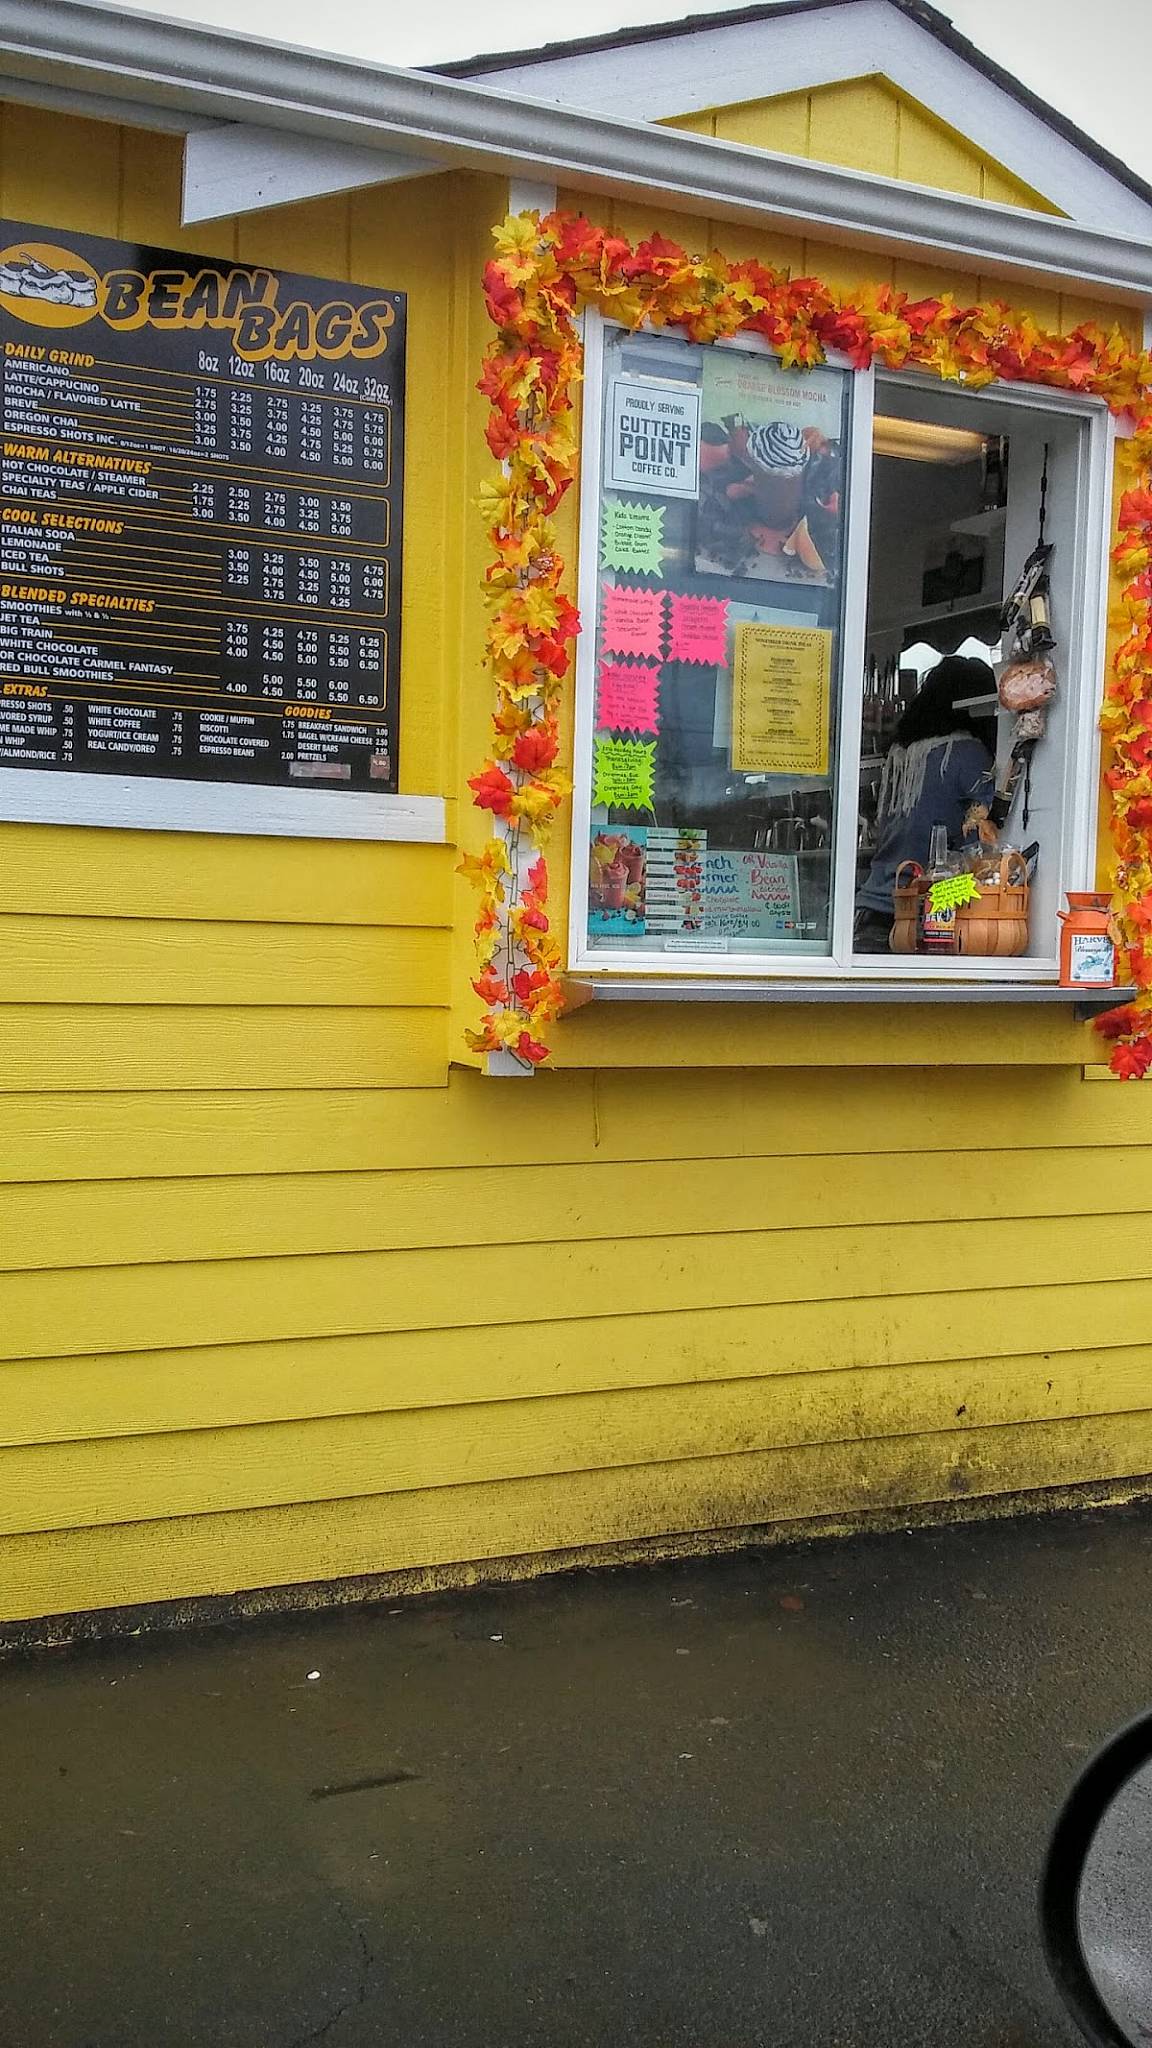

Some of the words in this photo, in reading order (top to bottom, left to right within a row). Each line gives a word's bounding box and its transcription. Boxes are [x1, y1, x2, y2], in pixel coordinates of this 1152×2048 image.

[101, 270, 277, 329] BEAN
[233, 302, 393, 359] BAGS
[5, 342, 46, 359] DAILY
[49, 350, 96, 367] GRIND
[198, 350, 219, 372] 8oz
[229, 356, 254, 378] 12oz
[264, 361, 290, 384] 16oz
[299, 367, 324, 389] 20oz
[333, 372, 358, 395] 24oz
[364, 378, 390, 399] 32oz
[4, 359, 70, 376] AMERICANO
[196, 386, 216, 398] 1.75
[232, 392, 251, 402] 2.25
[268, 397, 287, 408] 2.75
[302, 402, 321, 413] 3.25
[334, 407, 353, 418] 3.75
[364, 412, 384, 422] 4.75
[4, 384, 44, 398] MOCHA
[54, 390, 108, 407] FLAVORED
[110, 398, 141, 411] LATTE
[4, 371, 100, 393] LATTE/CAPPUCINO
[196, 399, 216, 410] 2.75
[231, 404, 252, 414] 3.25
[268, 409, 287, 420] 3.75
[302, 414, 321, 425] 4.25
[334, 420, 353, 430] 4.75
[364, 424, 384, 434] 5.75
[4, 397, 38, 410] BREVE
[626, 398, 655, 411] PROUDLY
[658, 402, 684, 415] SERVING
[4, 410, 50, 424] OREGON
[52, 416, 78, 428] CHAI
[4, 422, 58, 436] ESPRESSO
[60, 430, 94, 442] SHOTS
[96, 435, 118, 445] INC.
[620, 415, 691, 440] CUTTERS
[620, 432, 690, 466] POINT
[4, 443, 50, 460] WARM
[53, 450, 152, 474] ALTERNATIVES
[632, 462, 662, 476] COFFEE
[664, 467, 678, 478] CO.
[2, 460, 24, 471] HOT
[26, 462, 89, 479] CHOCOLATE
[98, 472, 146, 486] STEAMER
[193, 483, 214, 494] 2.25
[229, 488, 249, 498] 2.50
[265, 492, 285, 502] 2.75
[300, 497, 319, 507] 3.00
[332, 501, 350, 511] 3.50
[2, 485, 28, 496] CHAI
[31, 488, 57, 500] TEAS
[2, 472, 57, 487] SPECIALTY
[59, 479, 85, 491] TEAS
[93, 484, 126, 496] APPLE
[128, 488, 159, 500] CIDER
[193, 496, 214, 506] 1.75
[229, 500, 249, 510] 2.25
[265, 504, 285, 515] 2.75
[299, 509, 319, 519] 3.25
[332, 513, 350, 523] 3.75
[2, 508, 38, 524] COOL
[41, 512, 124, 535] SELECTIONS
[1, 524, 42, 537] ITALIAN
[45, 528, 76, 541] SODA
[229, 550, 248, 560] 3.00
[264, 553, 283, 564] 3.25
[300, 558, 318, 568] 3.50
[331, 561, 350, 571] 3.75
[364, 566, 383, 576] 4.75
[1, 550, 26, 560] ICED
[28, 552, 50, 563] TEA
[1, 537, 62, 552] LEMONADE
[228, 562, 248, 572] 3.50
[263, 566, 283, 576] 4.00
[299, 570, 318, 580] 4.50
[331, 573, 350, 583] 5.00
[364, 577, 383, 587] 6.00
[1, 562, 28, 573] BULL
[30, 564, 64, 576] SHOTS
[0, 584, 66, 603] BLENDED
[70, 592, 156, 612] SPECIALTIES
[0, 613, 17, 622] JET
[20, 614, 40, 625] TEA
[0, 600, 62, 614] SMOOTHIES
[65, 609, 82, 618] with
[227, 623, 248, 633] 3.75
[264, 628, 283, 637] 4.25
[298, 631, 317, 641] 4.75
[330, 634, 349, 644] 5.25
[360, 637, 379, 647] 6.25
[0, 626, 18, 635] BIG
[21, 627, 53, 638] TRAIN
[0, 638, 34, 649] WHITE
[36, 642, 98, 656] CHOCOLATE
[0, 650, 14, 660] OR
[18, 652, 80, 666] CHOCOLATE
[82, 658, 126, 670] CARMEL
[128, 662, 174, 675] FANTASY
[0, 662, 20, 672] RED
[24, 664, 50, 676] BULL
[53, 667, 114, 681] SMOOTHIES
[226, 683, 247, 692] 4.00
[263, 687, 282, 696] 4.50
[297, 690, 316, 699] 5.00
[329, 692, 348, 702] 5.50
[359, 695, 378, 704] 6.50
[3, 684, 48, 698] EXTRAS
[27, 702, 52, 712] SHOTS
[88, 705, 112, 715] WHITE
[113, 707, 157, 718] CHOCOLATE
[284, 706, 332, 720] GOODIES
[28, 714, 53, 724] SYRUP
[88, 716, 112, 726] WHITE
[113, 719, 141, 729] COFFEE
[200, 714, 224, 722] COOKIE
[230, 716, 254, 725] MUFFIN
[12, 725, 35, 734] MADE
[36, 726, 58, 736] WHIP
[88, 729, 132, 740] YOGURT/ICE
[132, 732, 159, 742] CREAM
[334, 724, 367, 734] SANDWICH
[5, 736, 25, 745] WHIP
[200, 734, 238, 745] CHOCOLATE
[239, 738, 270, 748] COVERED
[298, 732, 318, 740] BAGEL
[350, 736, 373, 745] CHEESE
[88, 741, 106, 750] REAL
[108, 742, 156, 753] CANDY/OREO
[200, 746, 232, 755] ESPRESSO
[233, 748, 254, 757] BEANS
[298, 742, 321, 751] DESERT
[322, 744, 338, 752] BARS
[298, 752, 326, 761] PRETZELS
